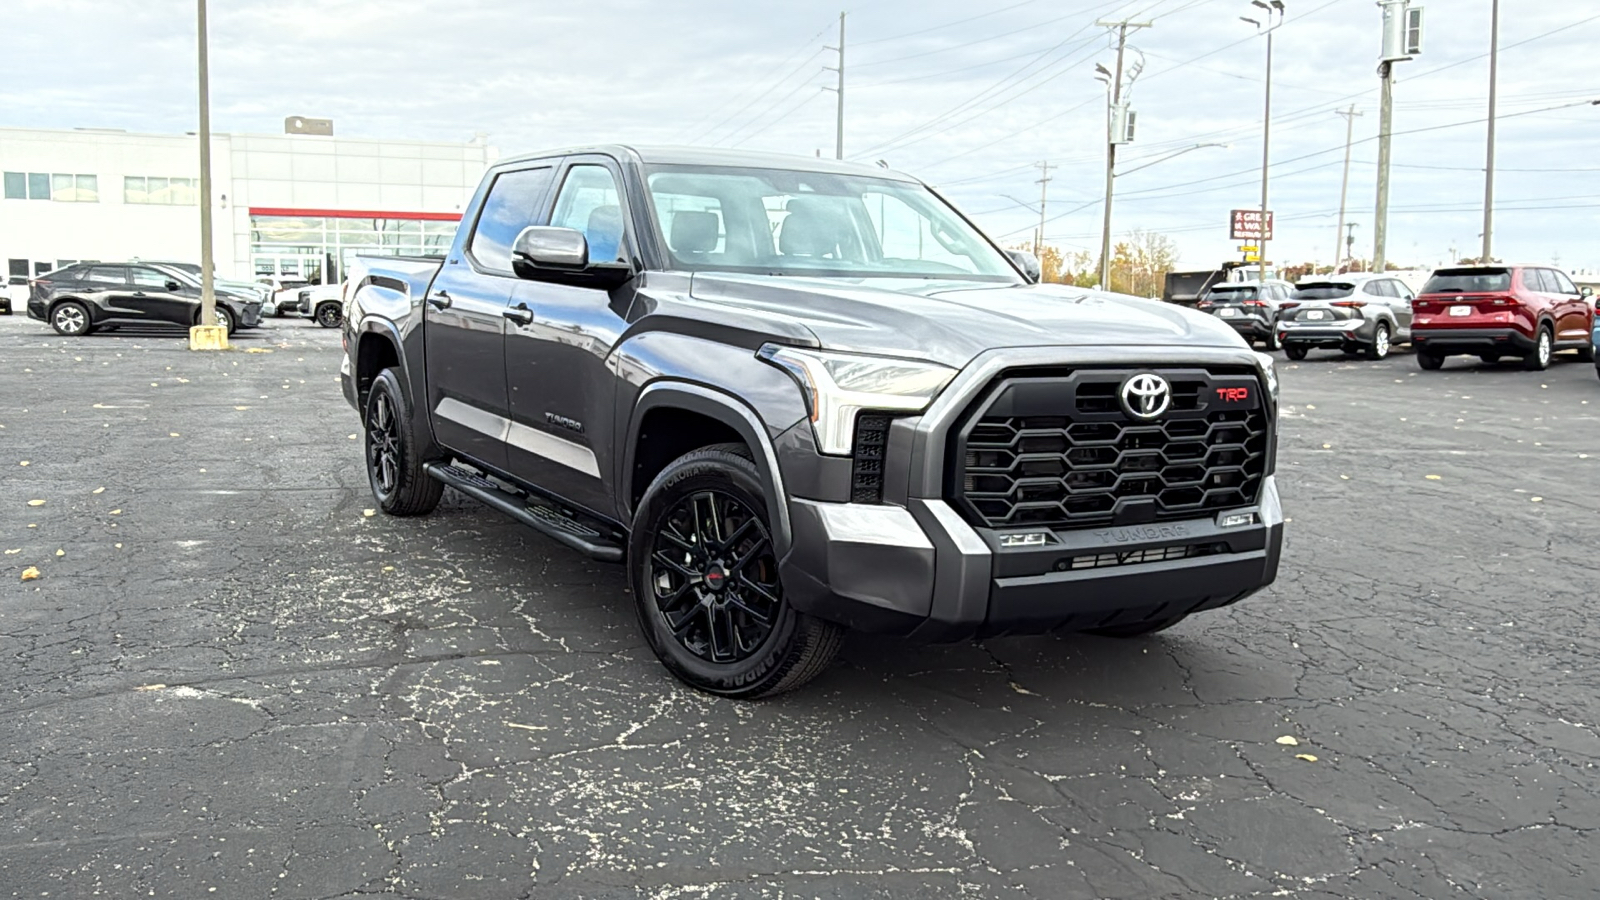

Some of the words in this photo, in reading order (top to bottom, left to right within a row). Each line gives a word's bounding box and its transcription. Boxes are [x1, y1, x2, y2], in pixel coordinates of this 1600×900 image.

[1243, 213, 1271, 221] GRET
[1244, 222, 1269, 230] WAL
[1216, 387, 1248, 402] TRD
[1093, 525, 1190, 543] TUNDRA
